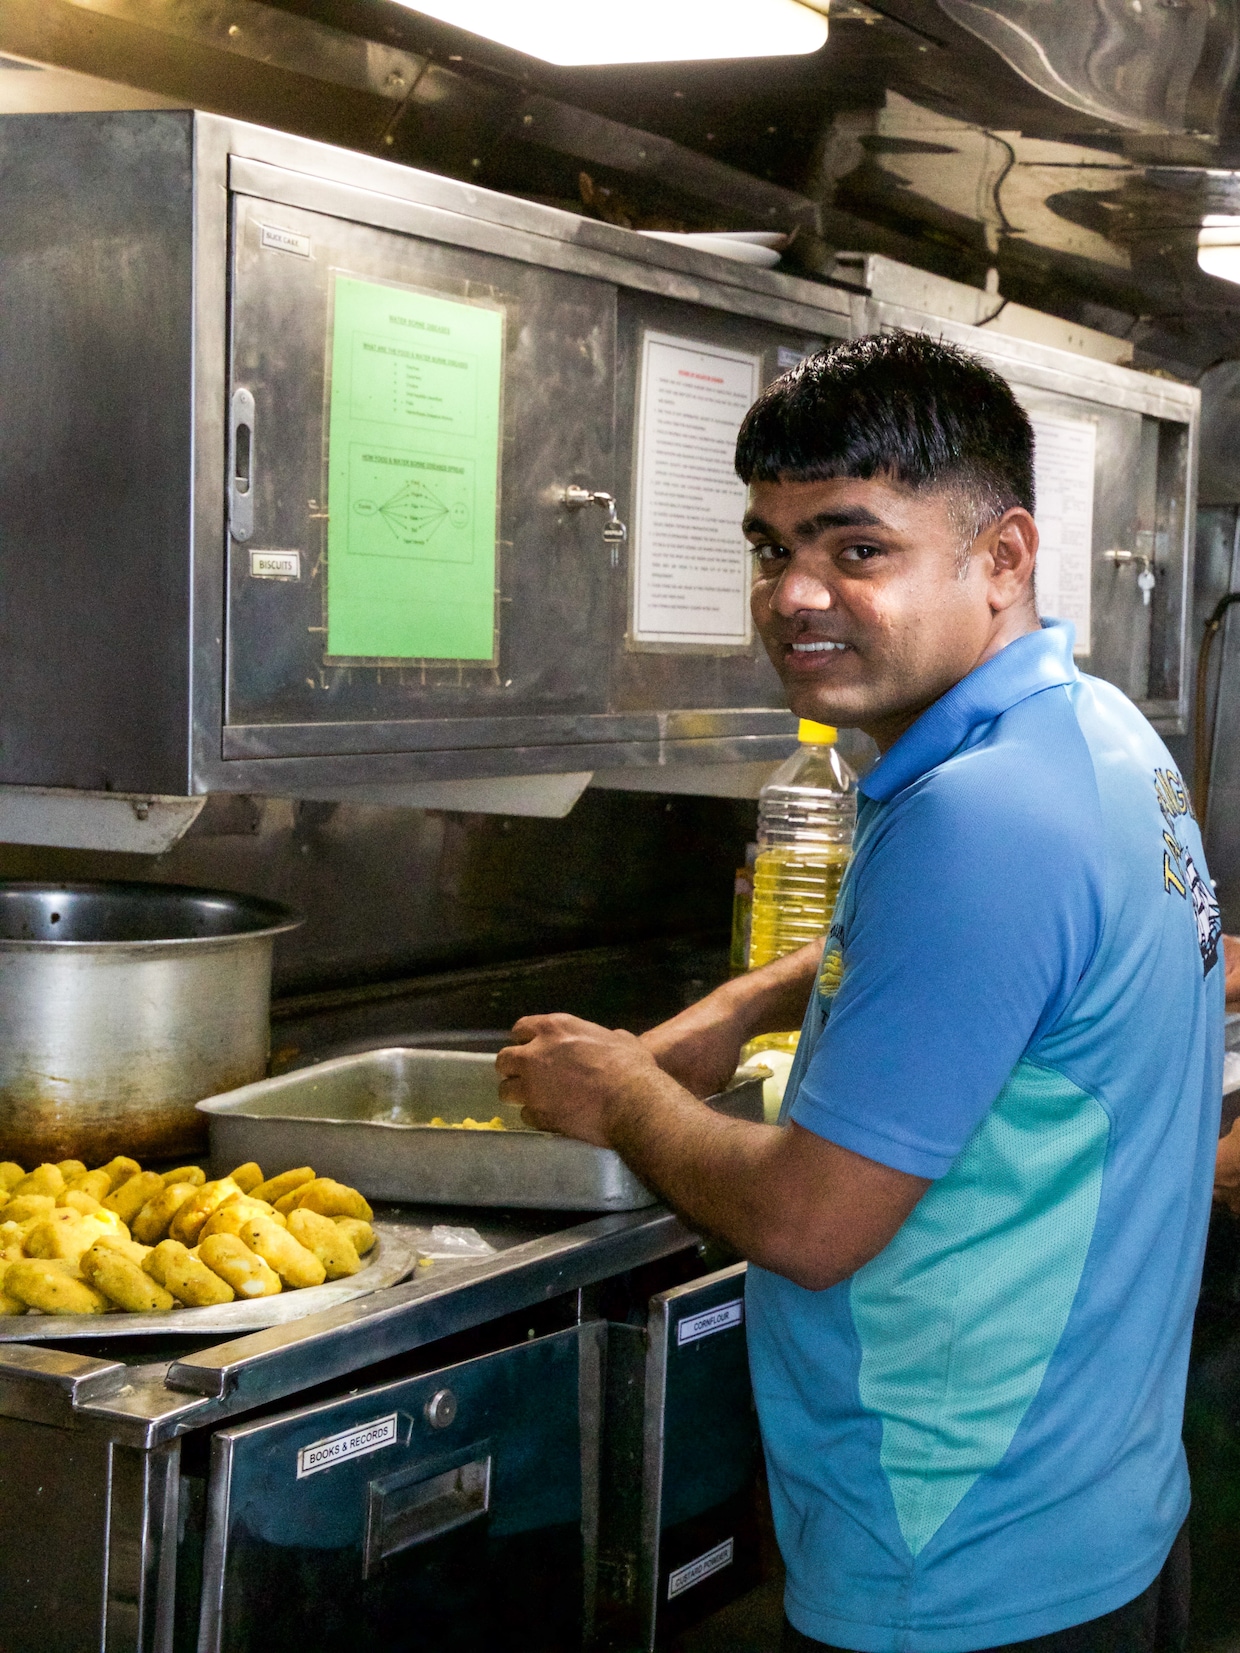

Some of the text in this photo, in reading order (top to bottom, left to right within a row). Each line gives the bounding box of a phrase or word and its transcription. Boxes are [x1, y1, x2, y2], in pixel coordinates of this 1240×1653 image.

[259, 560, 292, 571] BISCUITS
[694, 1312, 729, 1331] CORNFLOUR
[310, 1426, 389, 1464] BOOKS & RECORDS
[675, 1549, 729, 1588] CUSTARD POWDER
